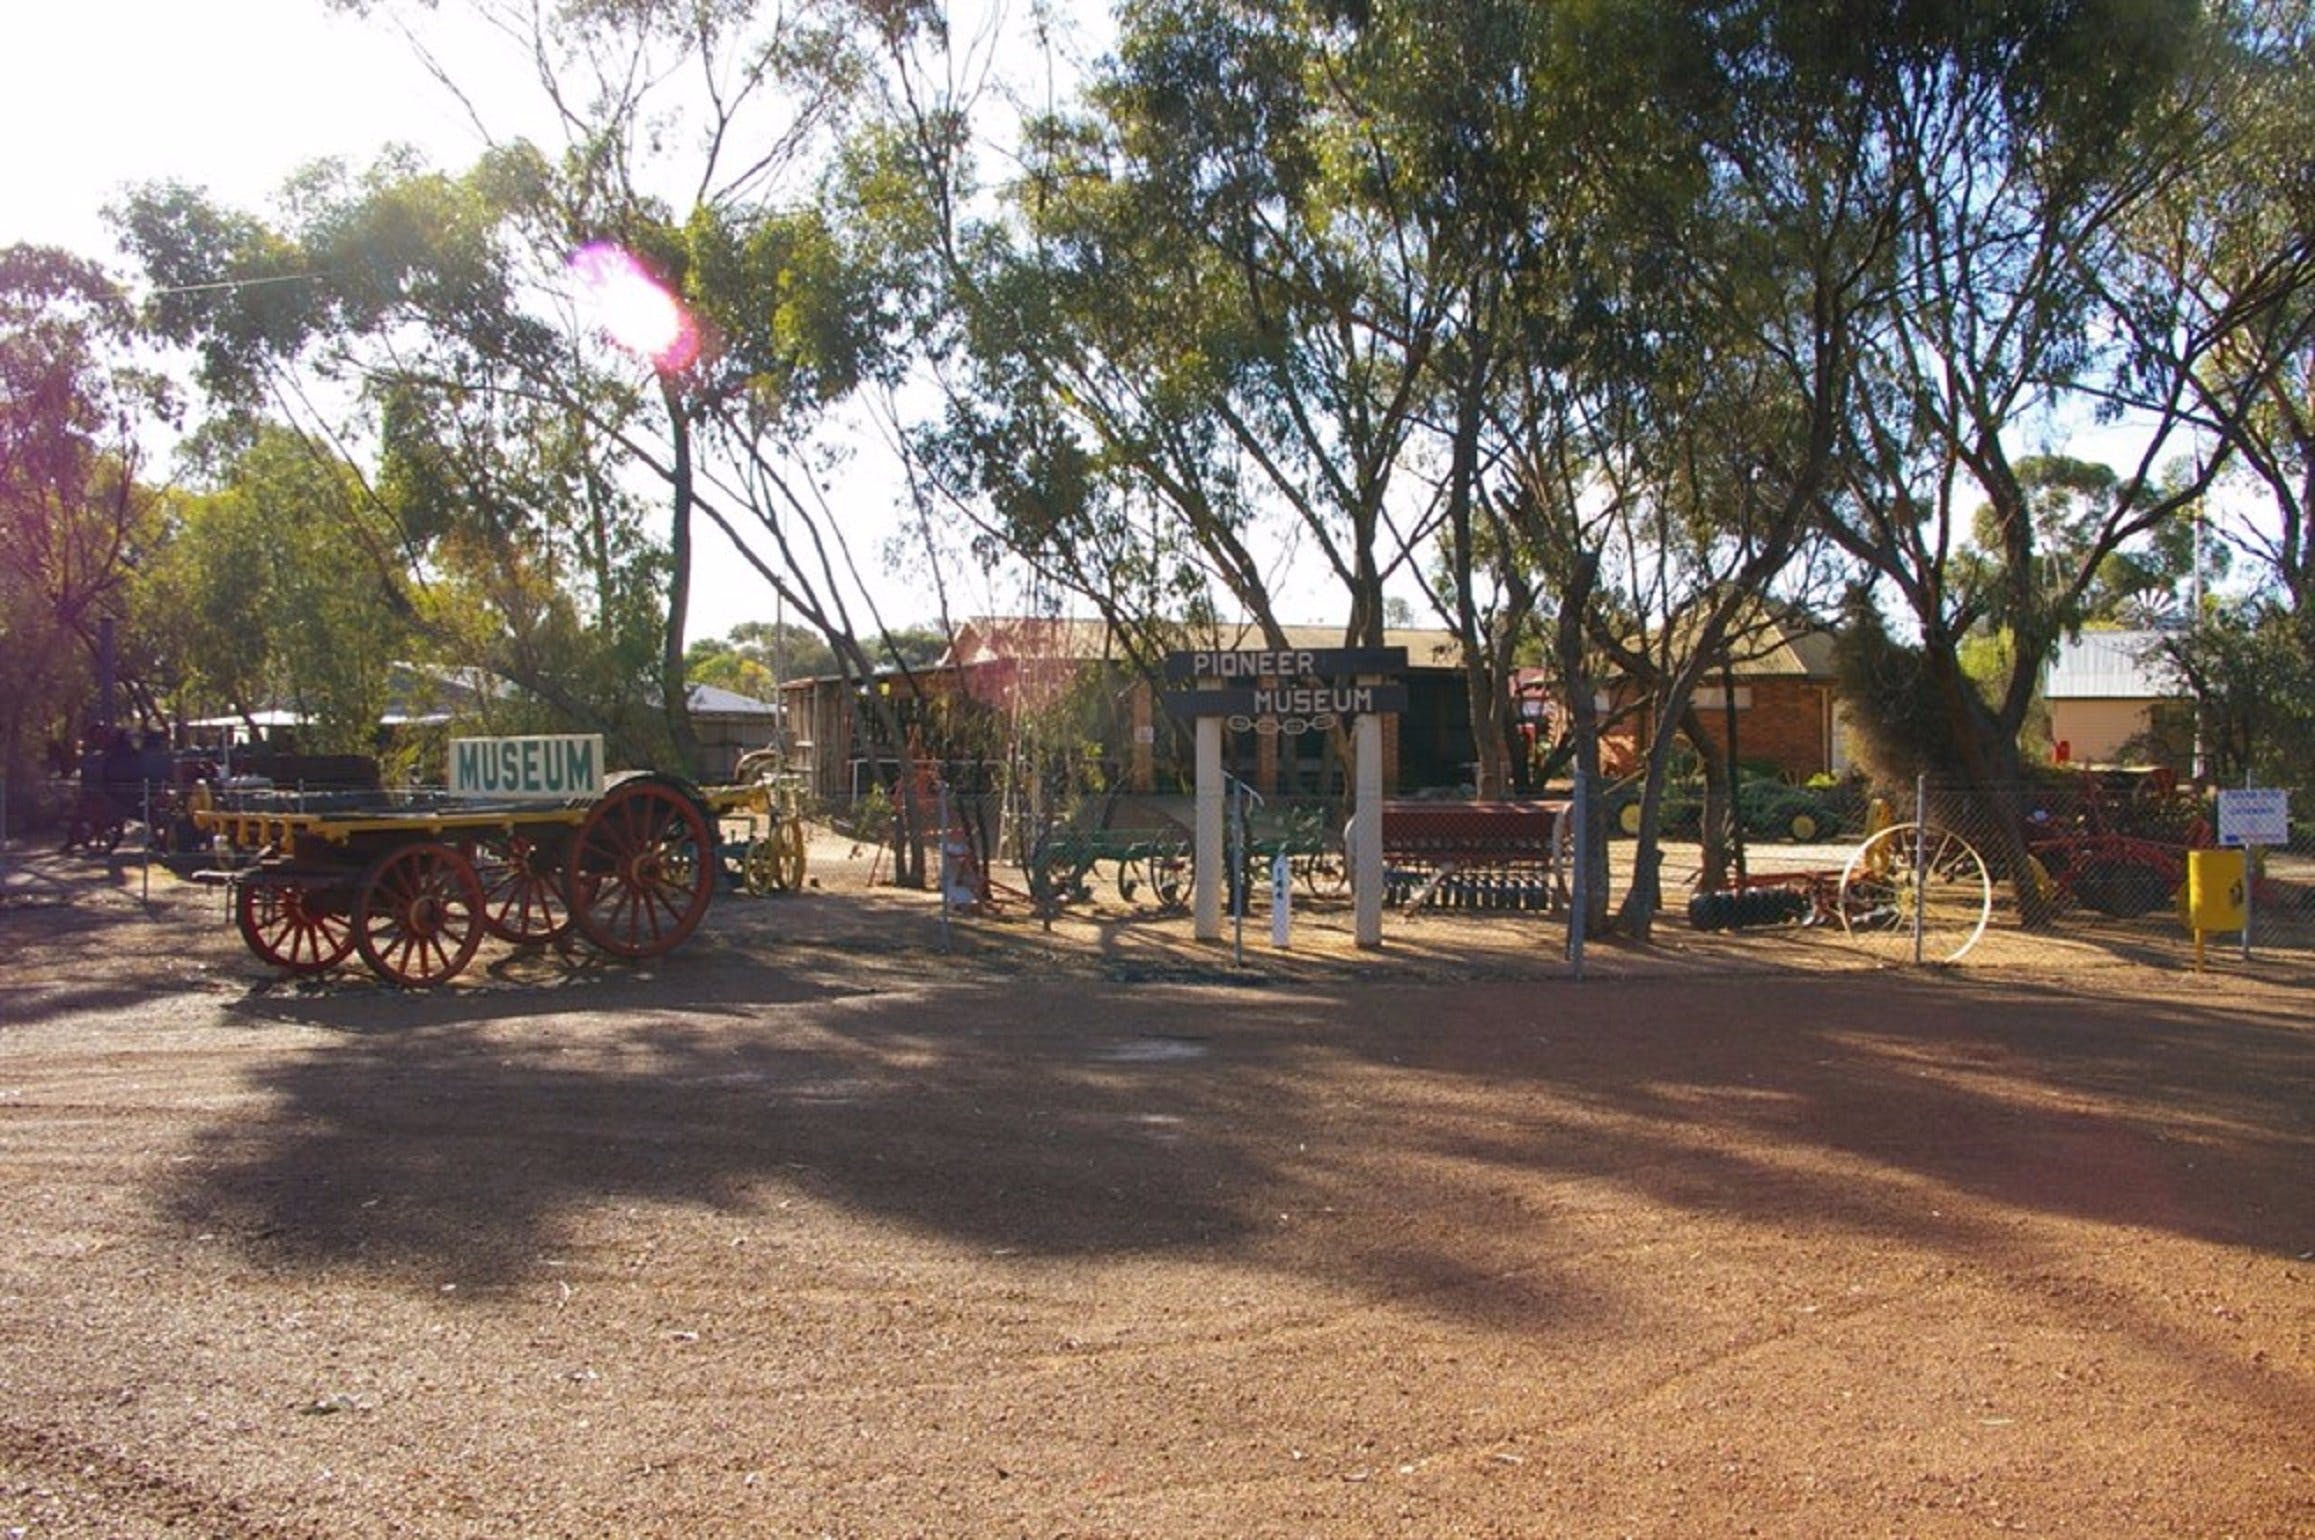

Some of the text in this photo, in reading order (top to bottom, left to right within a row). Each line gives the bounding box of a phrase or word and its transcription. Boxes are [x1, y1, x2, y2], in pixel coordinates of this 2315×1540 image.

[1193, 651, 1315, 677] PIONEER
[1253, 687, 1373, 714] MUSEUM
[458, 740, 594, 792] MUSEUM
